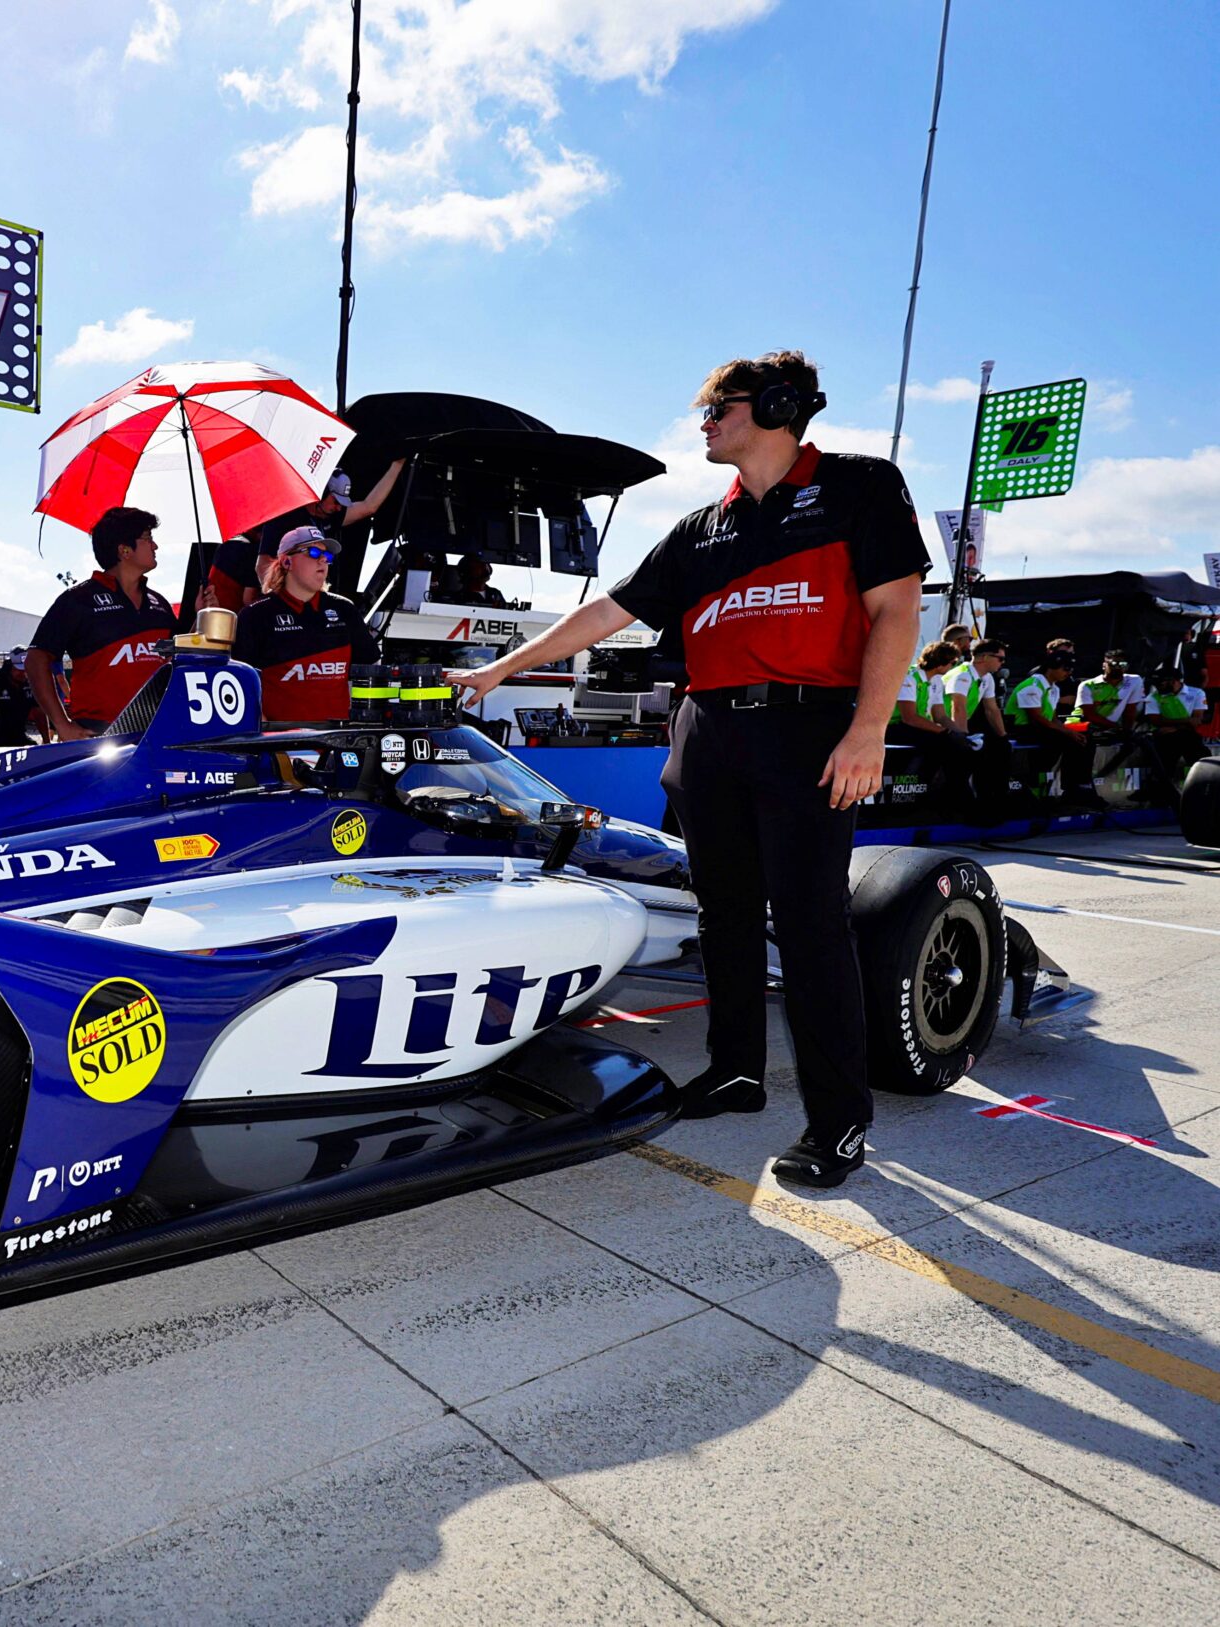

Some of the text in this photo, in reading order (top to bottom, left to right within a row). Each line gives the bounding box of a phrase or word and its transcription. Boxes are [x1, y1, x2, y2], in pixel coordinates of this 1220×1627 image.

[1007, 456, 1040, 466] DALY
[695, 531, 739, 549] HONDA
[94, 605, 124, 613] HONDA
[719, 582, 824, 614] ABEL
[763, 606, 804, 617] Company
[806, 605, 823, 613] Inc.
[472, 620, 523, 636] ABEL
[184, 671, 246, 727] 50
[204, 771, 238, 784] ABE
[892, 784, 927, 794] HOLLINGER
[336, 825, 365, 848] SOLD
[74, 995, 153, 1047] MECUM
[301, 963, 605, 1079] Lite
[899, 977, 927, 1076] Firestone
[79, 1022, 163, 1088] SOLD
[93, 1155, 122, 1177] NTT
[5, 1208, 113, 1259] Firestone
